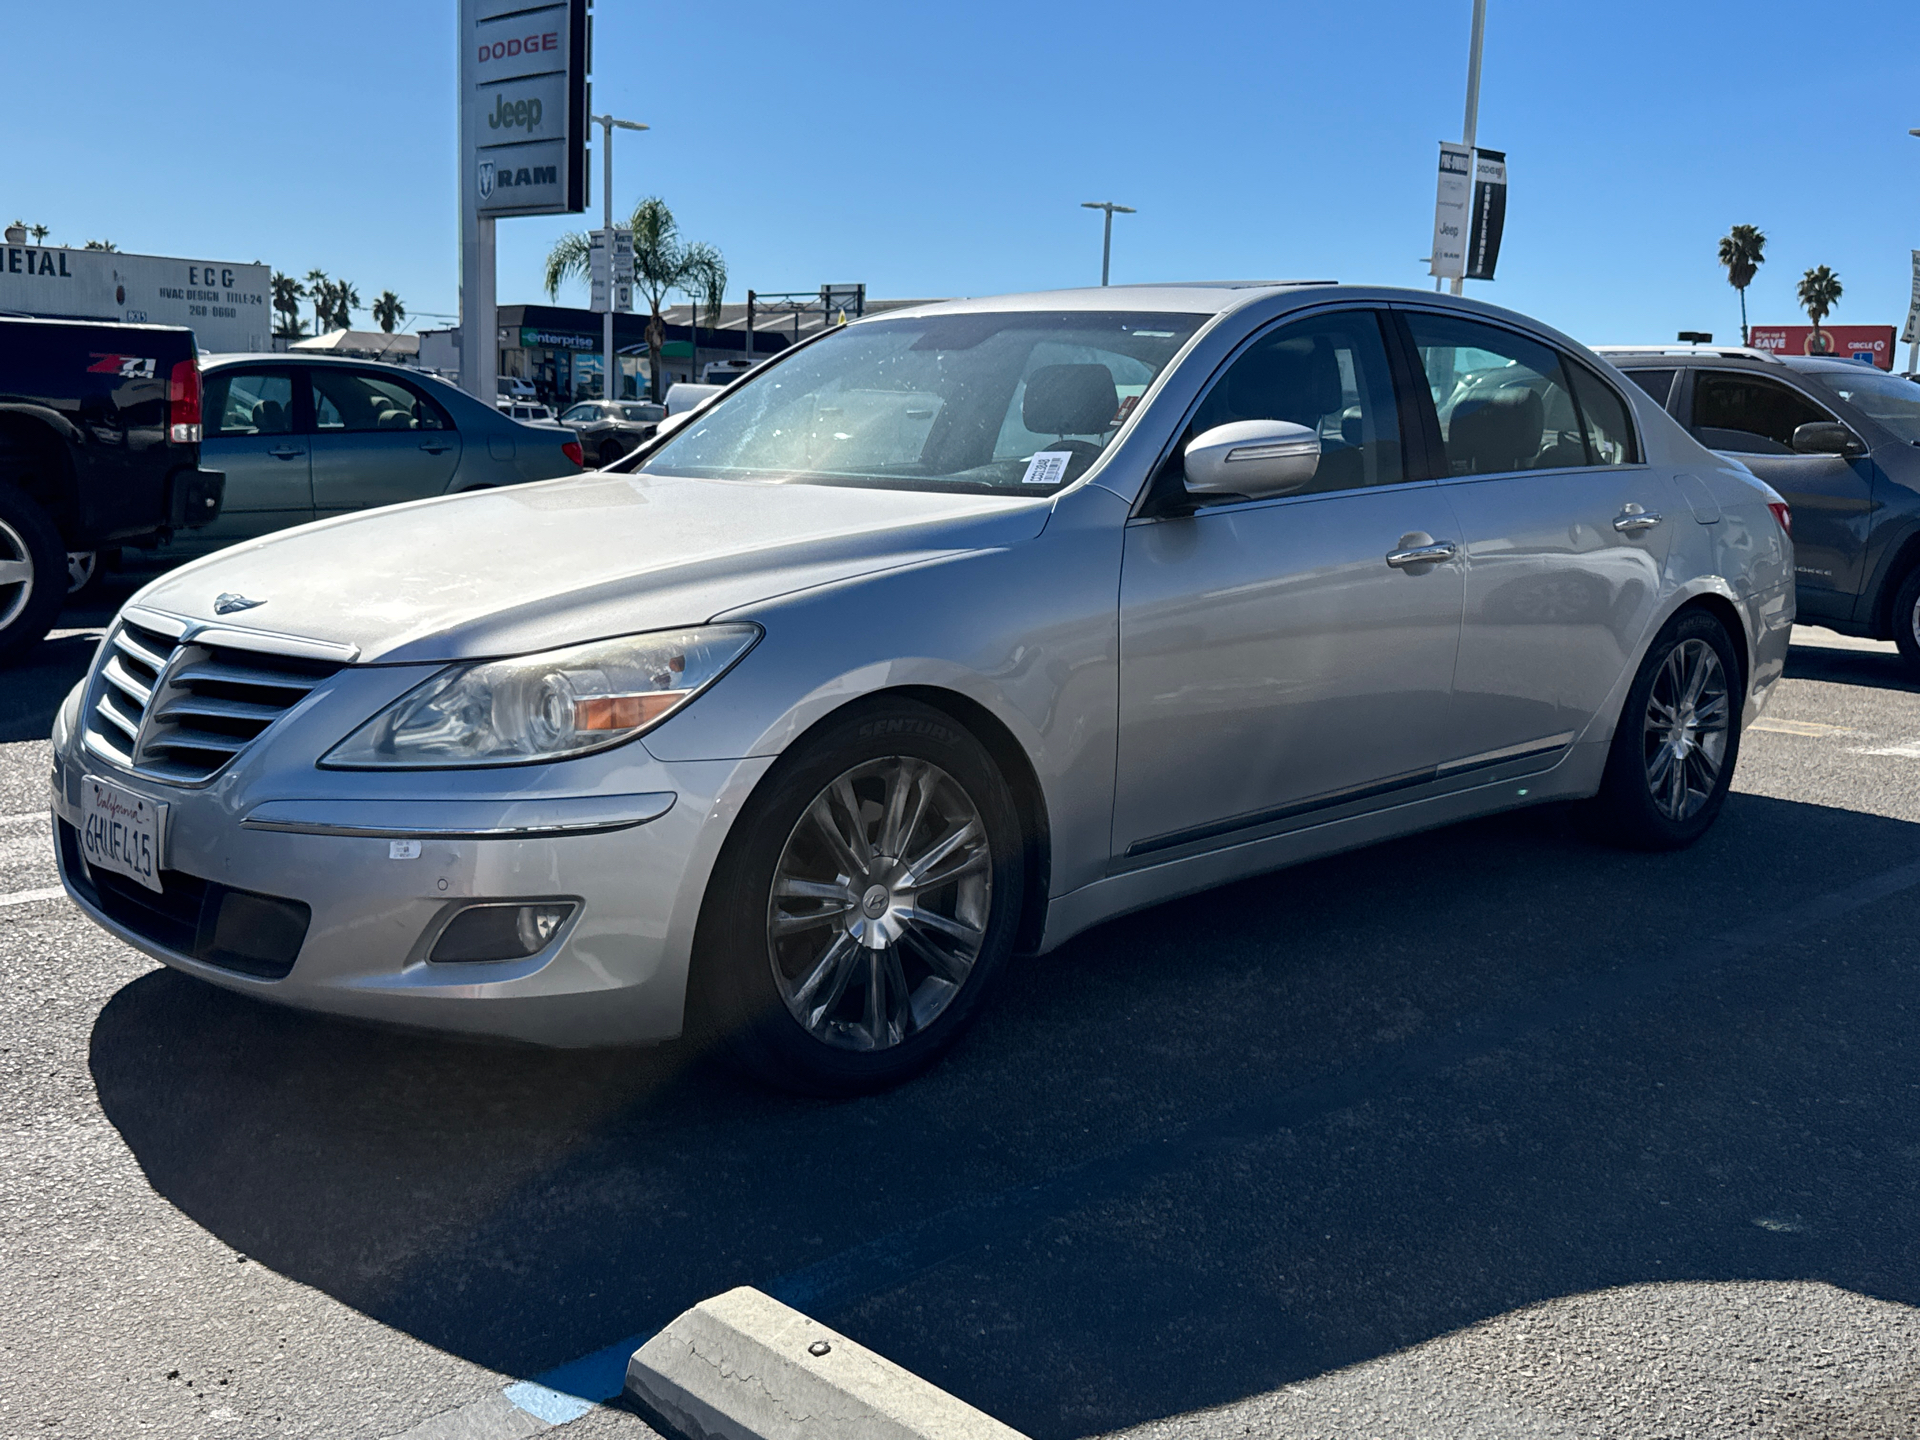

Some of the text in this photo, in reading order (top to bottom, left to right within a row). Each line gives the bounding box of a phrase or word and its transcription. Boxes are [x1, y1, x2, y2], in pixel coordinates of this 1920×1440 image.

[478, 32, 558, 63] DODGE
[488, 93, 543, 133] Jeep
[497, 165, 557, 188] RAM
[1439, 222, 1459, 239] Jeep
[159, 287, 184, 300] HVAC
[187, 289, 219, 302] DESIGN
[526, 332, 594, 347] enterprise
[1755, 339, 1786, 348] SAVE
[1848, 342, 1872, 350] CIRCLE
[87, 353, 157, 374] Z71
[1794, 566, 1832, 576] OKEE
[858, 719, 961, 746] SENTURY
[96, 788, 142, 824] California
[86, 813, 151, 877] 6HUF415
